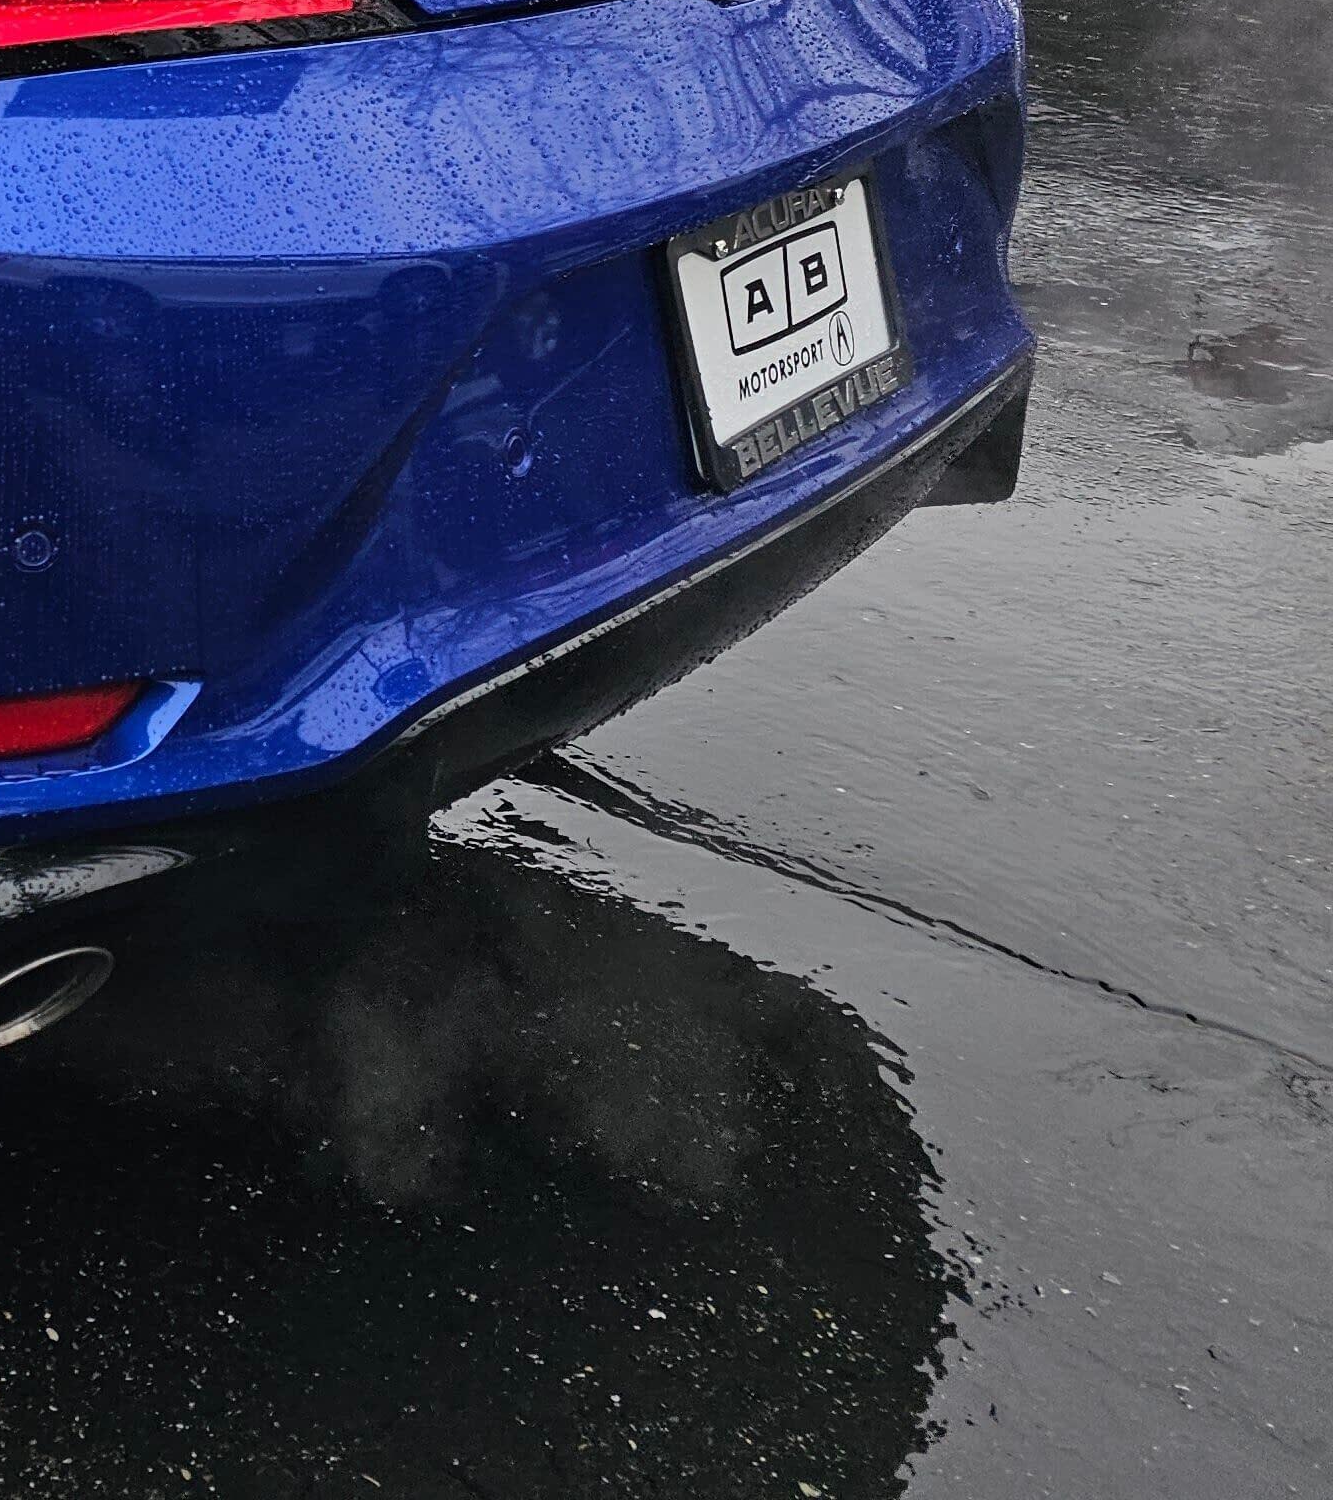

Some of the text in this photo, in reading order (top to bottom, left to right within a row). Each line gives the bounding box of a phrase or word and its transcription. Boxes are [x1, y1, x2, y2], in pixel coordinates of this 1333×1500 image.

[733, 188, 827, 250] ACURA
[744, 252, 828, 324] A B
[738, 339, 824, 401] MOTORSPORT
[732, 356, 899, 478] BELLEVUE
